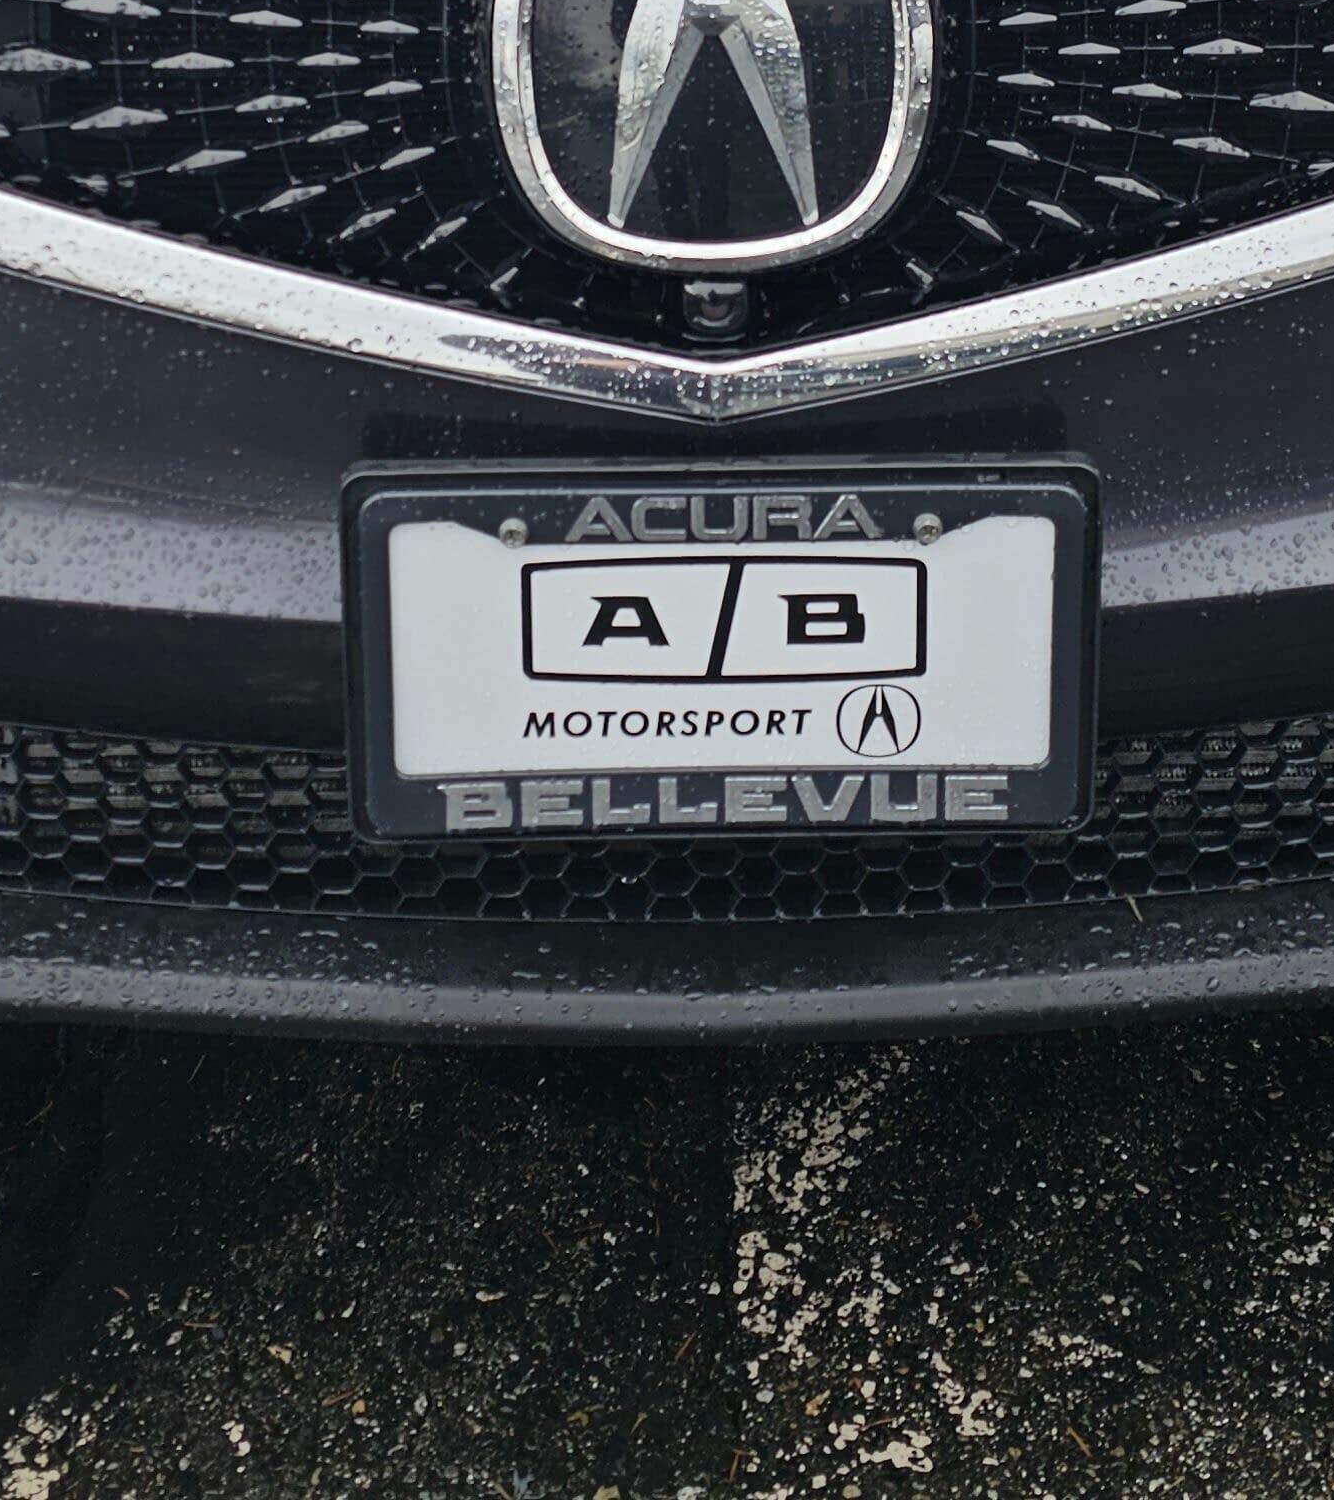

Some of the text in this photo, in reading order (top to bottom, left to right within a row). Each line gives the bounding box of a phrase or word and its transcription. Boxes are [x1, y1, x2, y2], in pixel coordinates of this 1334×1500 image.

[565, 494, 883, 543] ACURA
[522, 708, 813, 739] MOTORSPORT
[435, 773, 1009, 831] BELLEVUE
